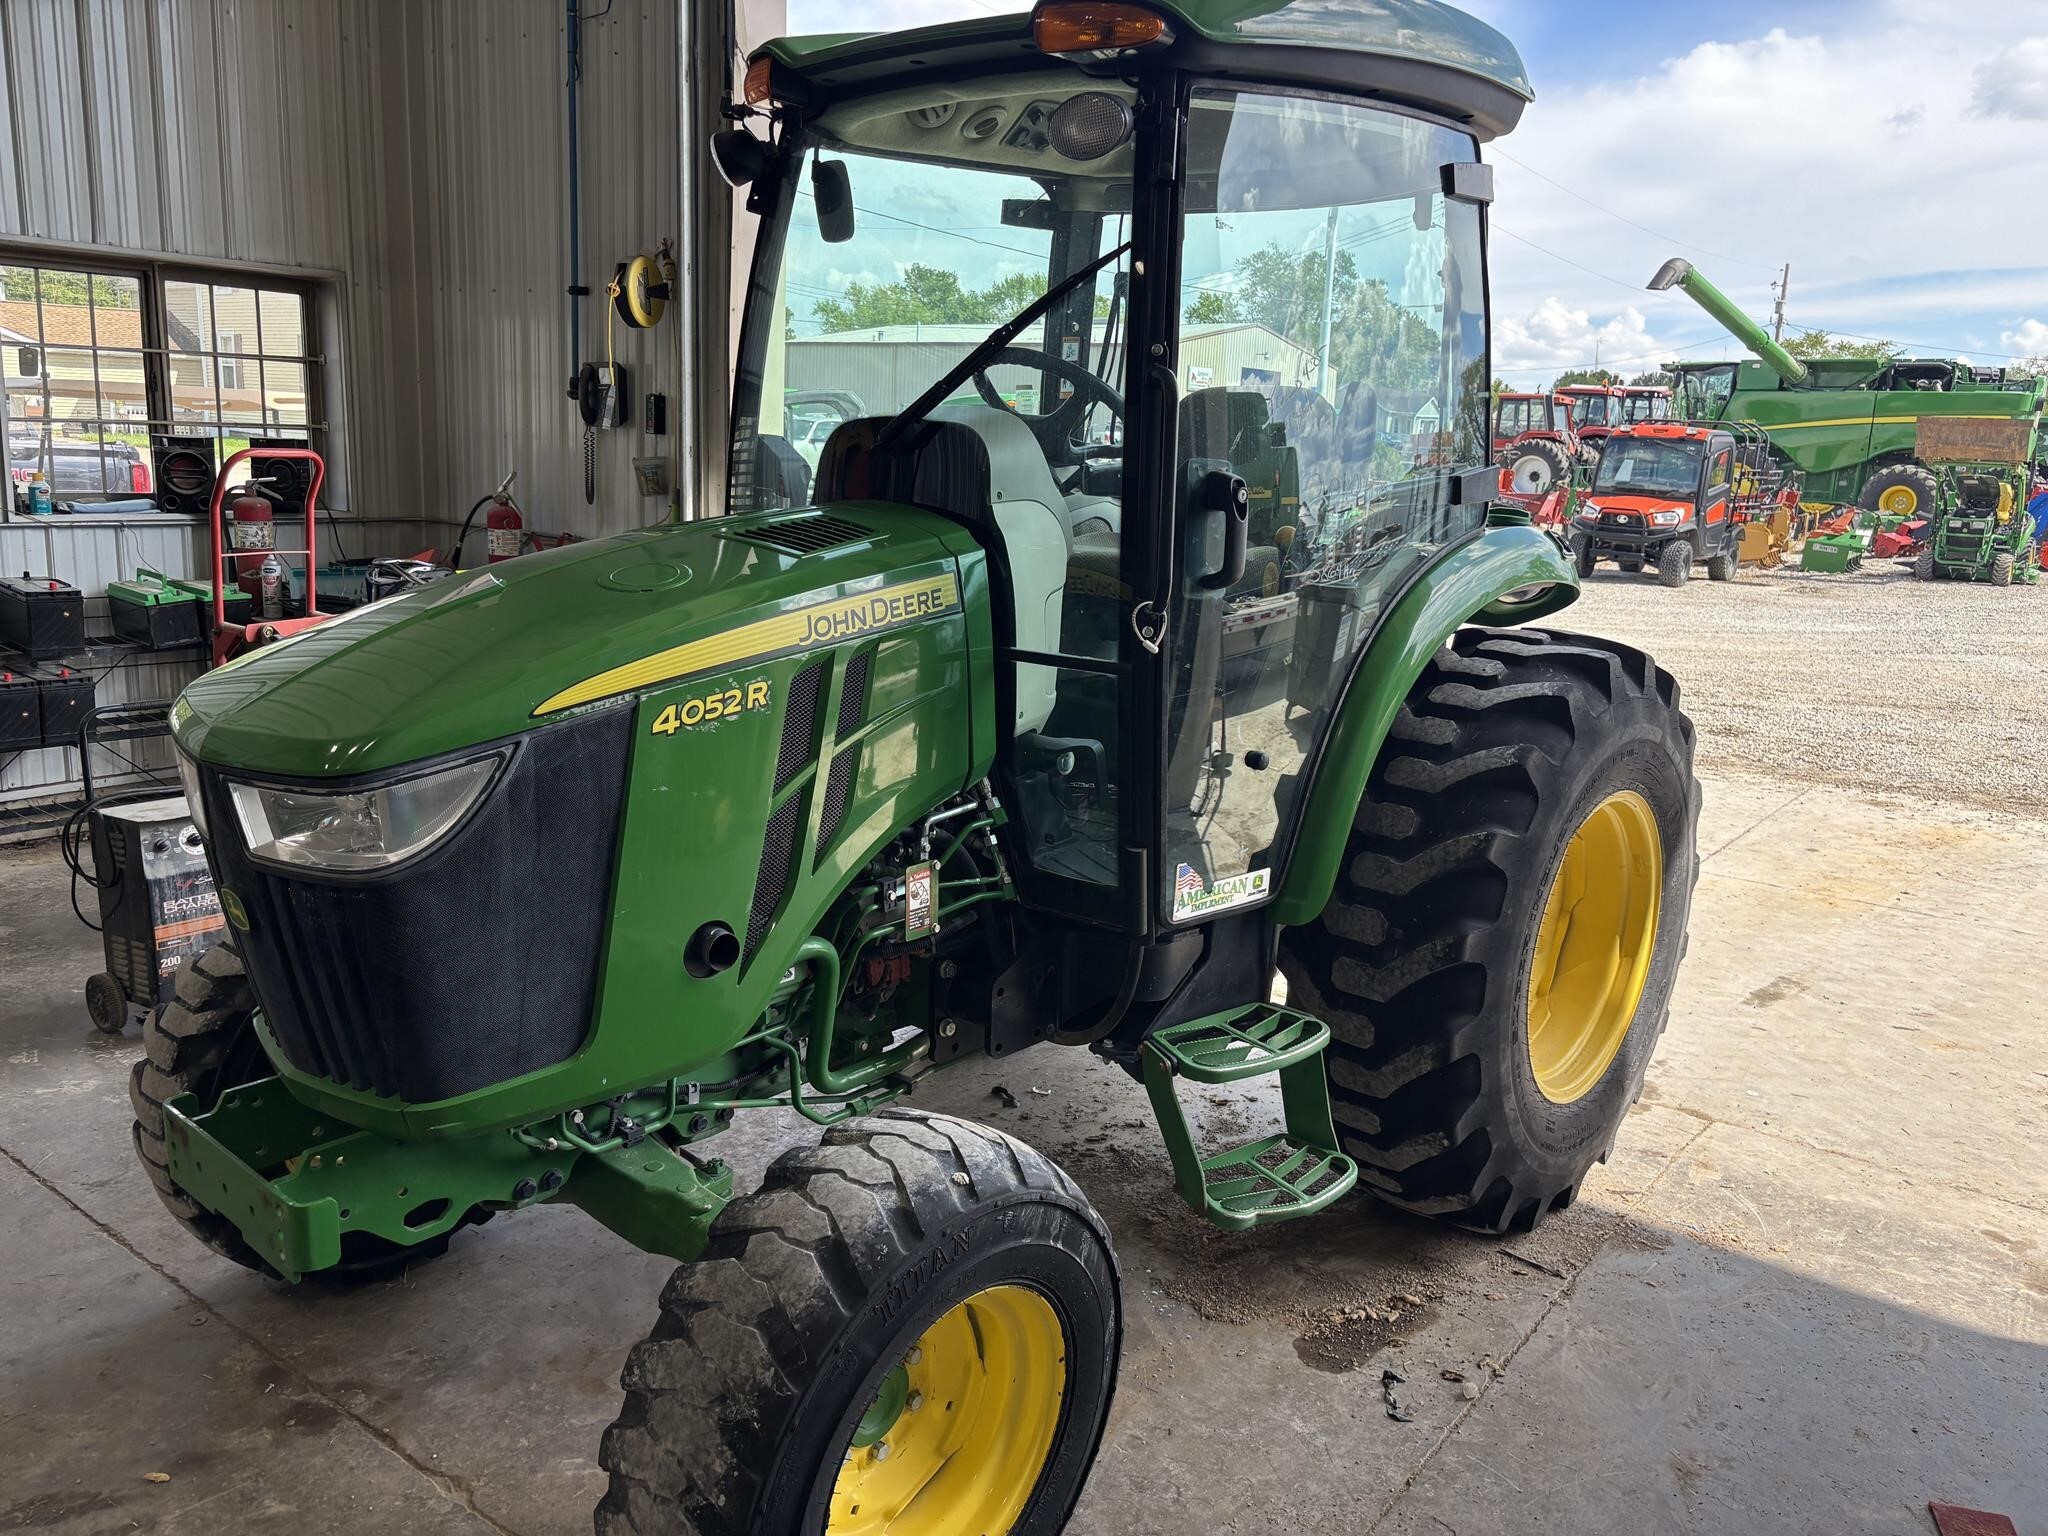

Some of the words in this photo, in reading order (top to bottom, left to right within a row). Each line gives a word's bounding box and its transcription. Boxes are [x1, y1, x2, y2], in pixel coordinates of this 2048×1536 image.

[798, 605, 868, 642] JOHN
[869, 586, 944, 625] DEERE
[163, 892, 219, 908] BATTE
[164, 899, 222, 914] CHARG
[1190, 894, 1235, 913] IMPLEMENT
[160, 955, 181, 968] 200
[864, 1223, 976, 1328] TITAN
